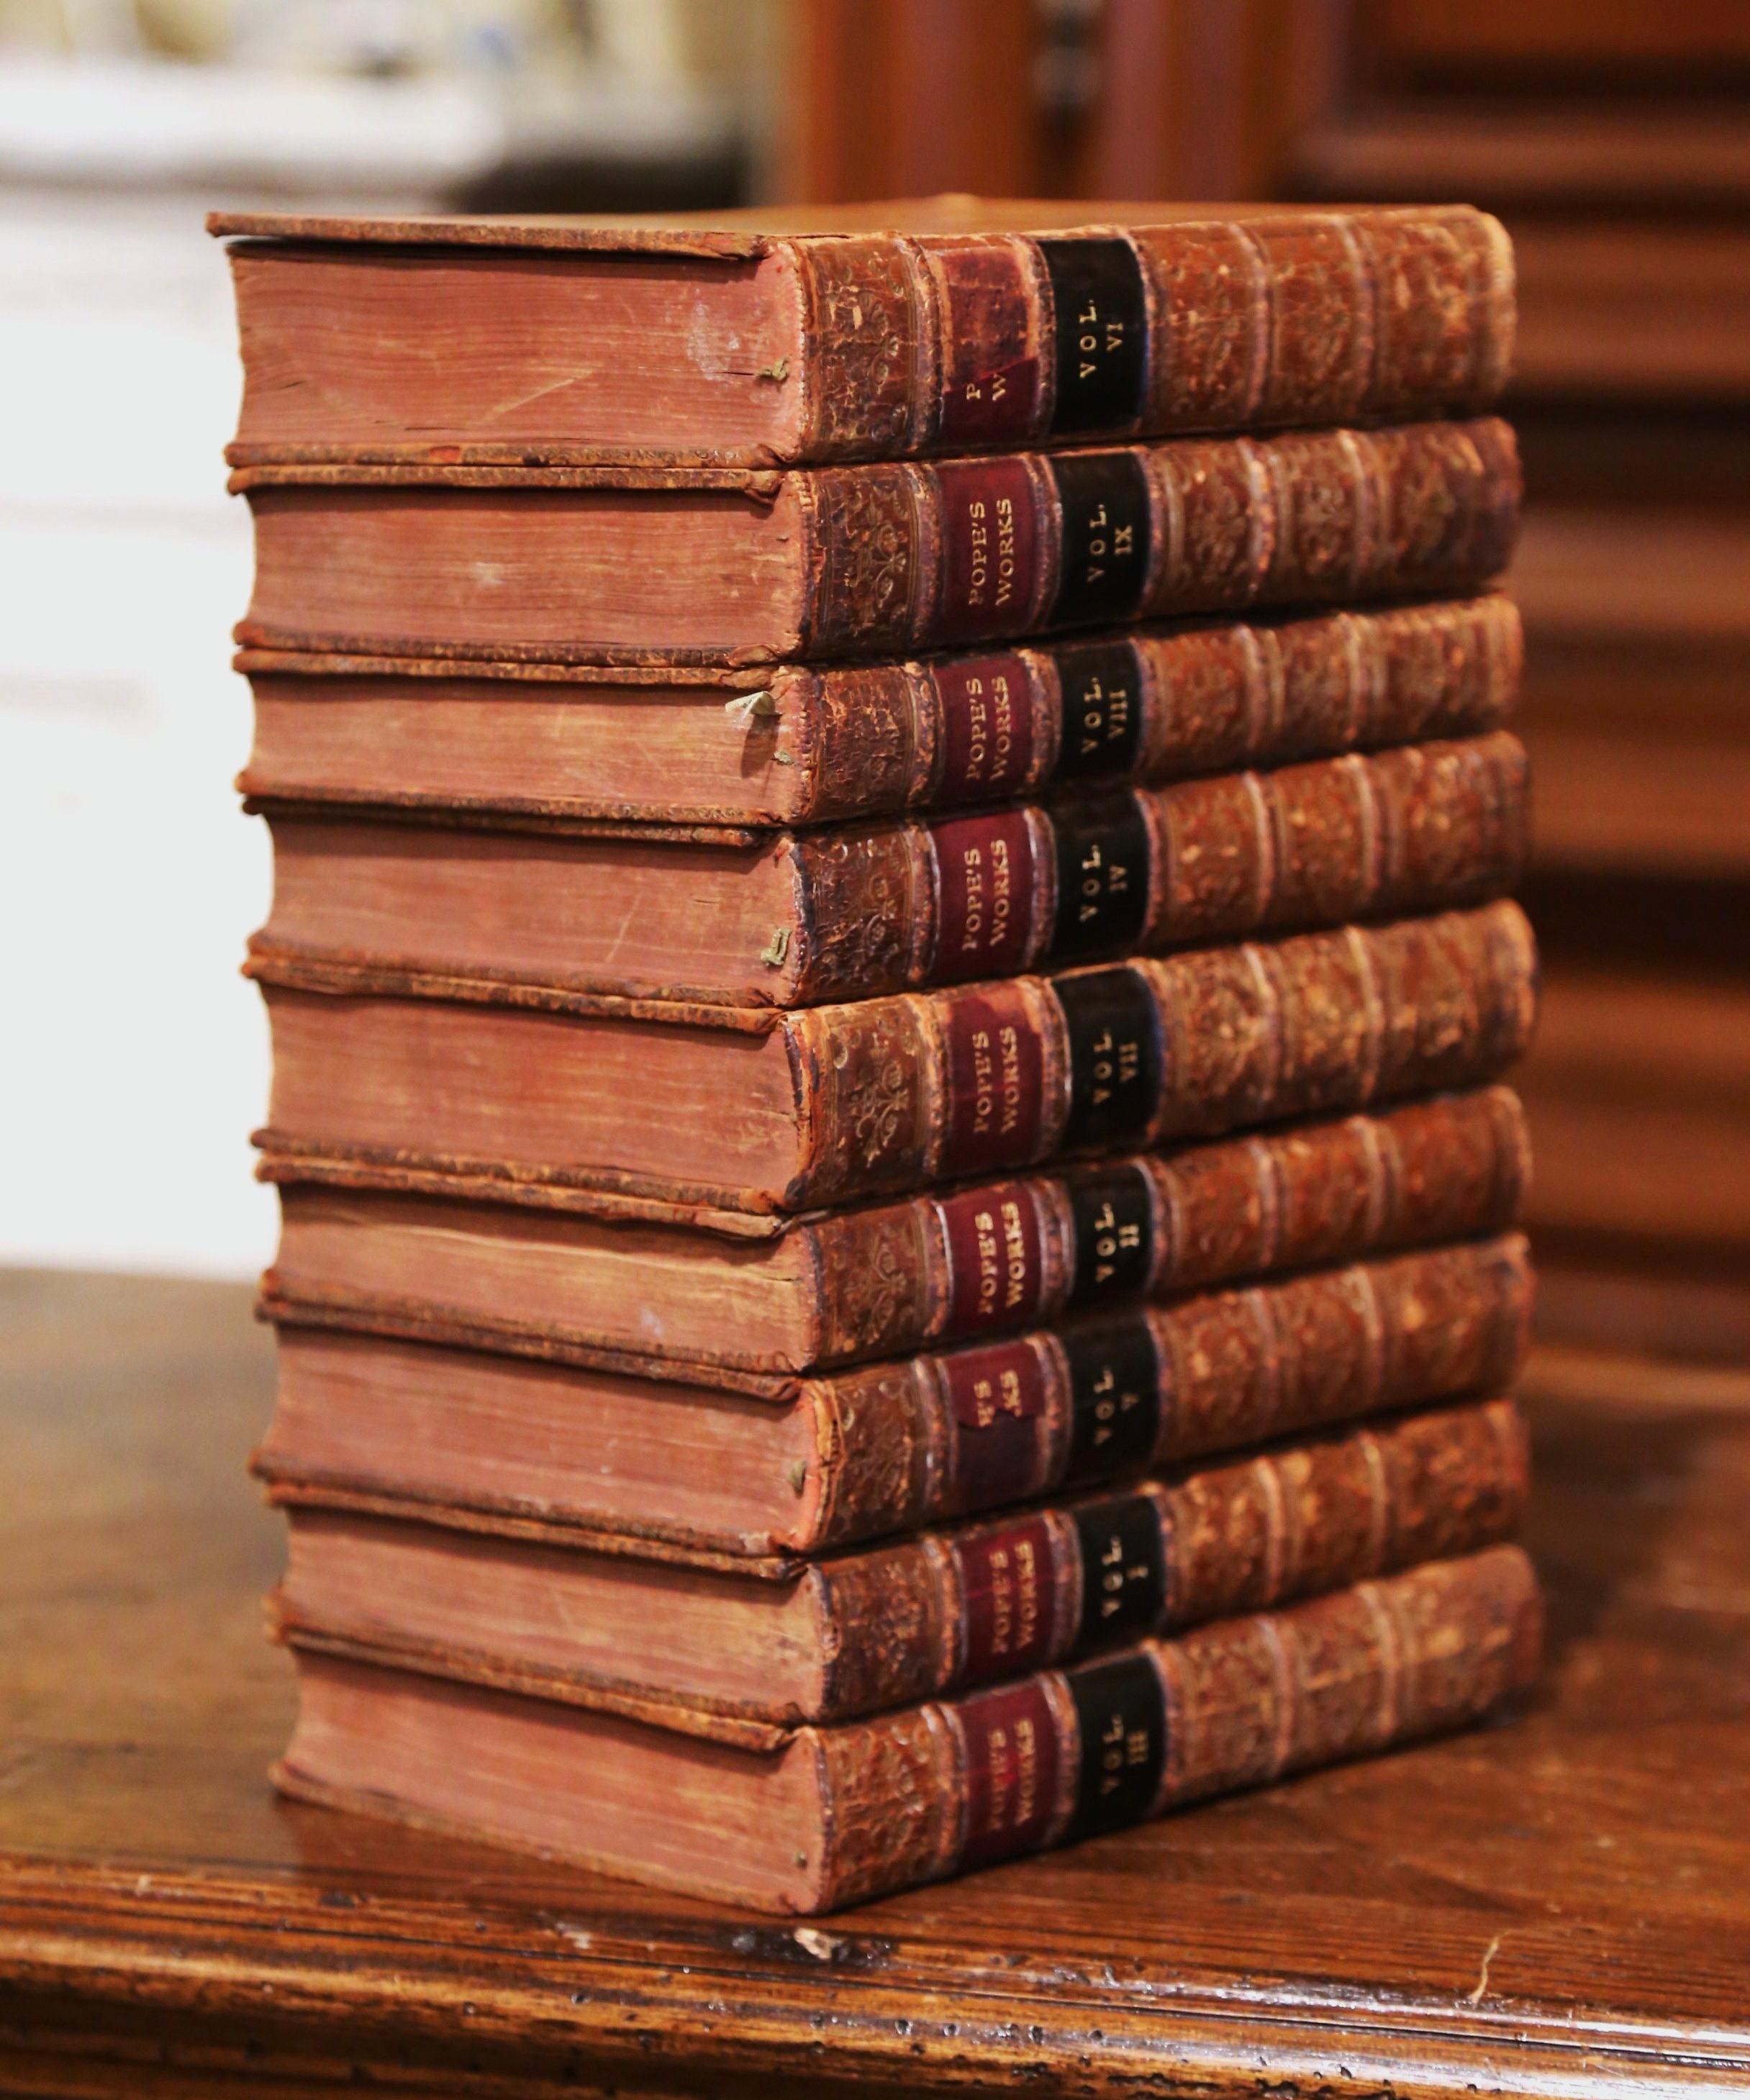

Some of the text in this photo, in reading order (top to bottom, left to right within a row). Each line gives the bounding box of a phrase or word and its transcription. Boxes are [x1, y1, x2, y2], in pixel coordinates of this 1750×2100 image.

[1107, 323, 1124, 352] VI
[969, 501, 987, 606] POPE'S
[995, 499, 1014, 606] WORKS
[1115, 525, 1133, 555] IX
[966, 678, 987, 781] POPE'S
[989, 676, 1010, 781] WORKS
[1107, 689, 1128, 740] VIII
[962, 848, 982, 951] POPE'S
[989, 839, 1010, 947] WORKS
[1109, 865, 1128, 892] IV
[972, 1031, 992, 1134] POPE'S
[1000, 1027, 1020, 1134] WORKS
[1118, 1042, 1138, 1082] VII
[975, 1212, 998, 1314] POPE'S
[1001, 1201, 1025, 1309] WORKS
[1118, 1224, 1140, 1248] II
[989, 1550, 1012, 1653] POPE'S
[1015, 1540, 1038, 1650] WORKS
[988, 1728, 1007, 1830] POPE'S
[1015, 1717, 1035, 1827] WORKS
[1126, 1731, 1149, 1765] III
